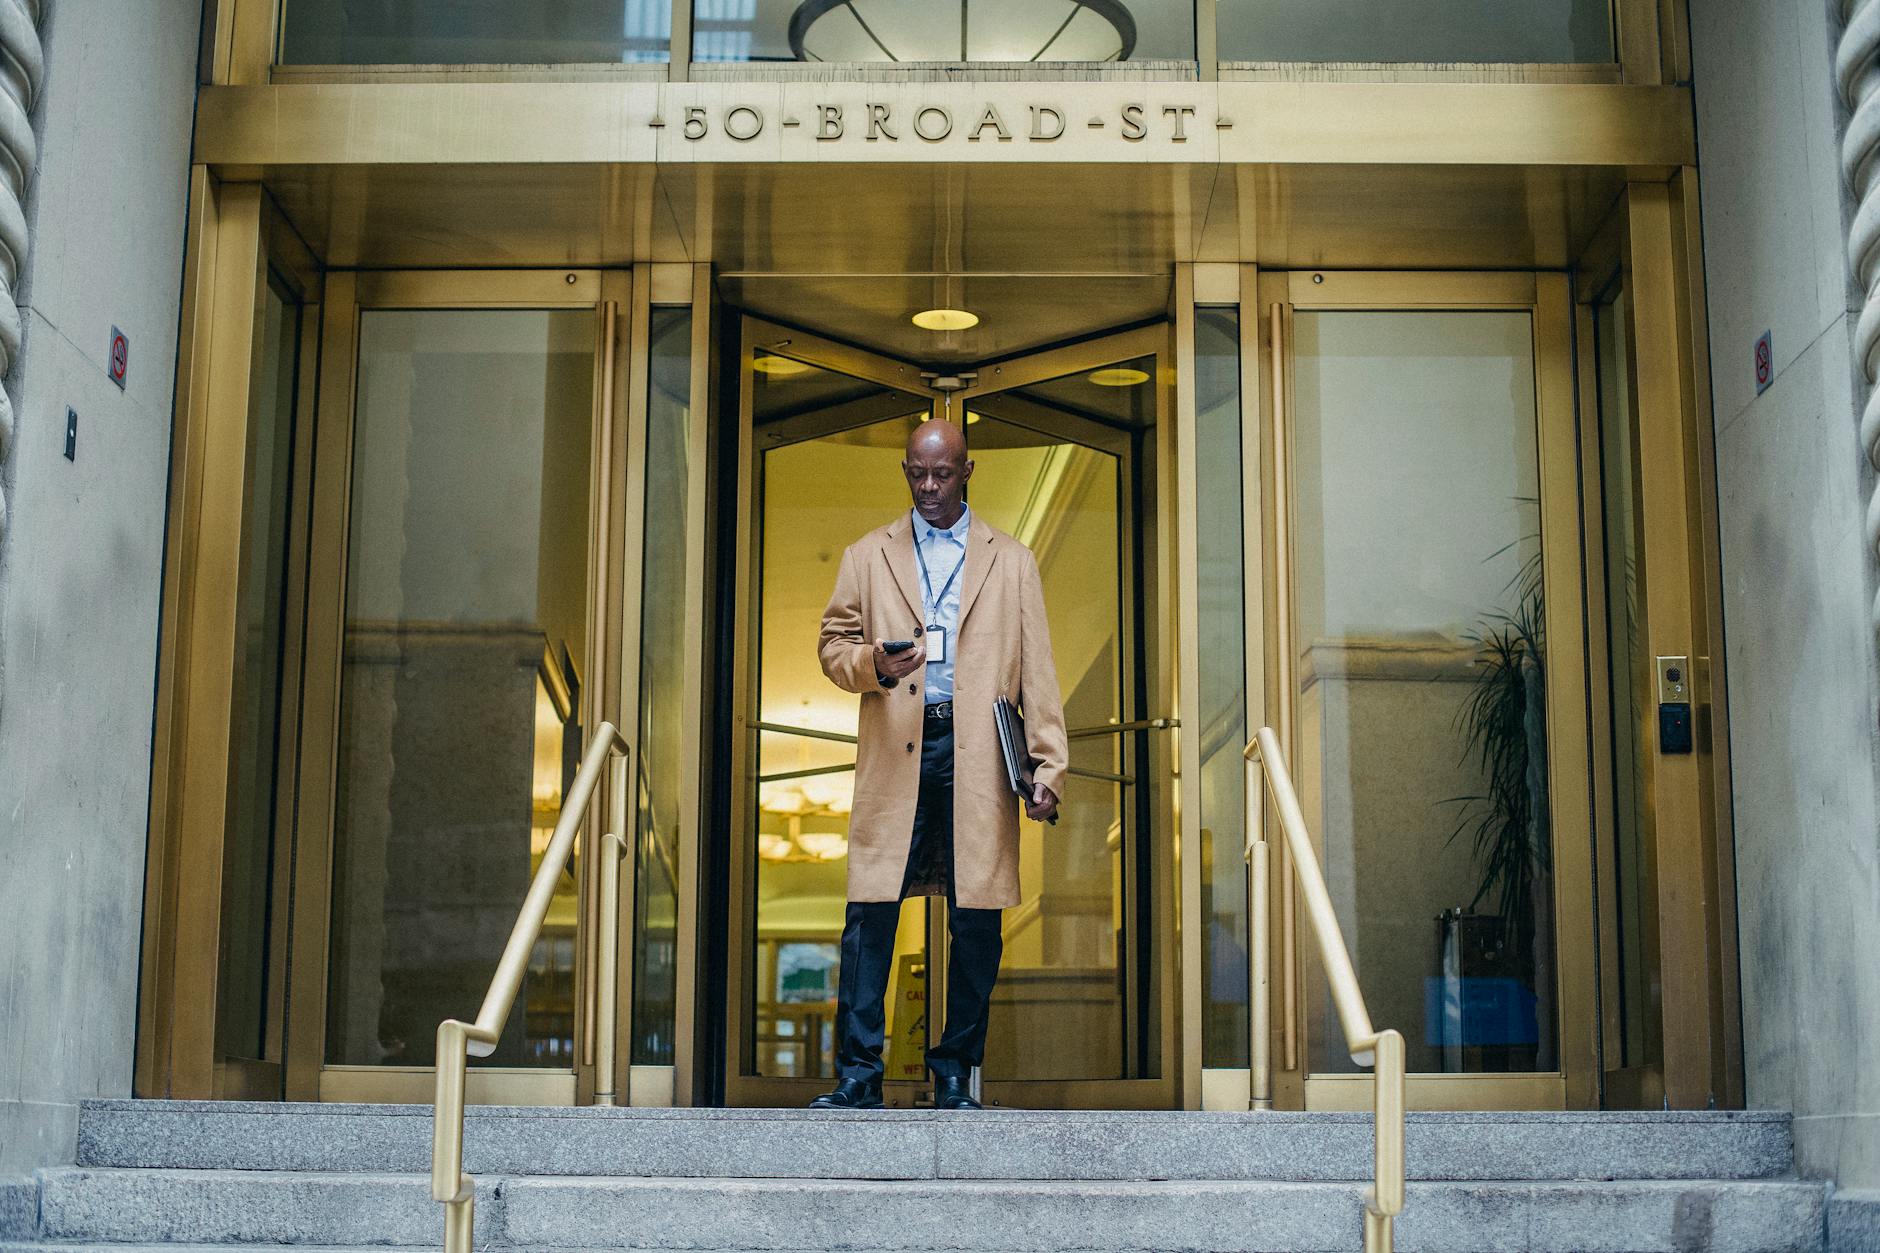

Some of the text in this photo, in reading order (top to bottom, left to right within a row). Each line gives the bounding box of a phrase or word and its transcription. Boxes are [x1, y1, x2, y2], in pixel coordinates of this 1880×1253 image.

[683, 103, 1197, 143] 50 BROAD ST
